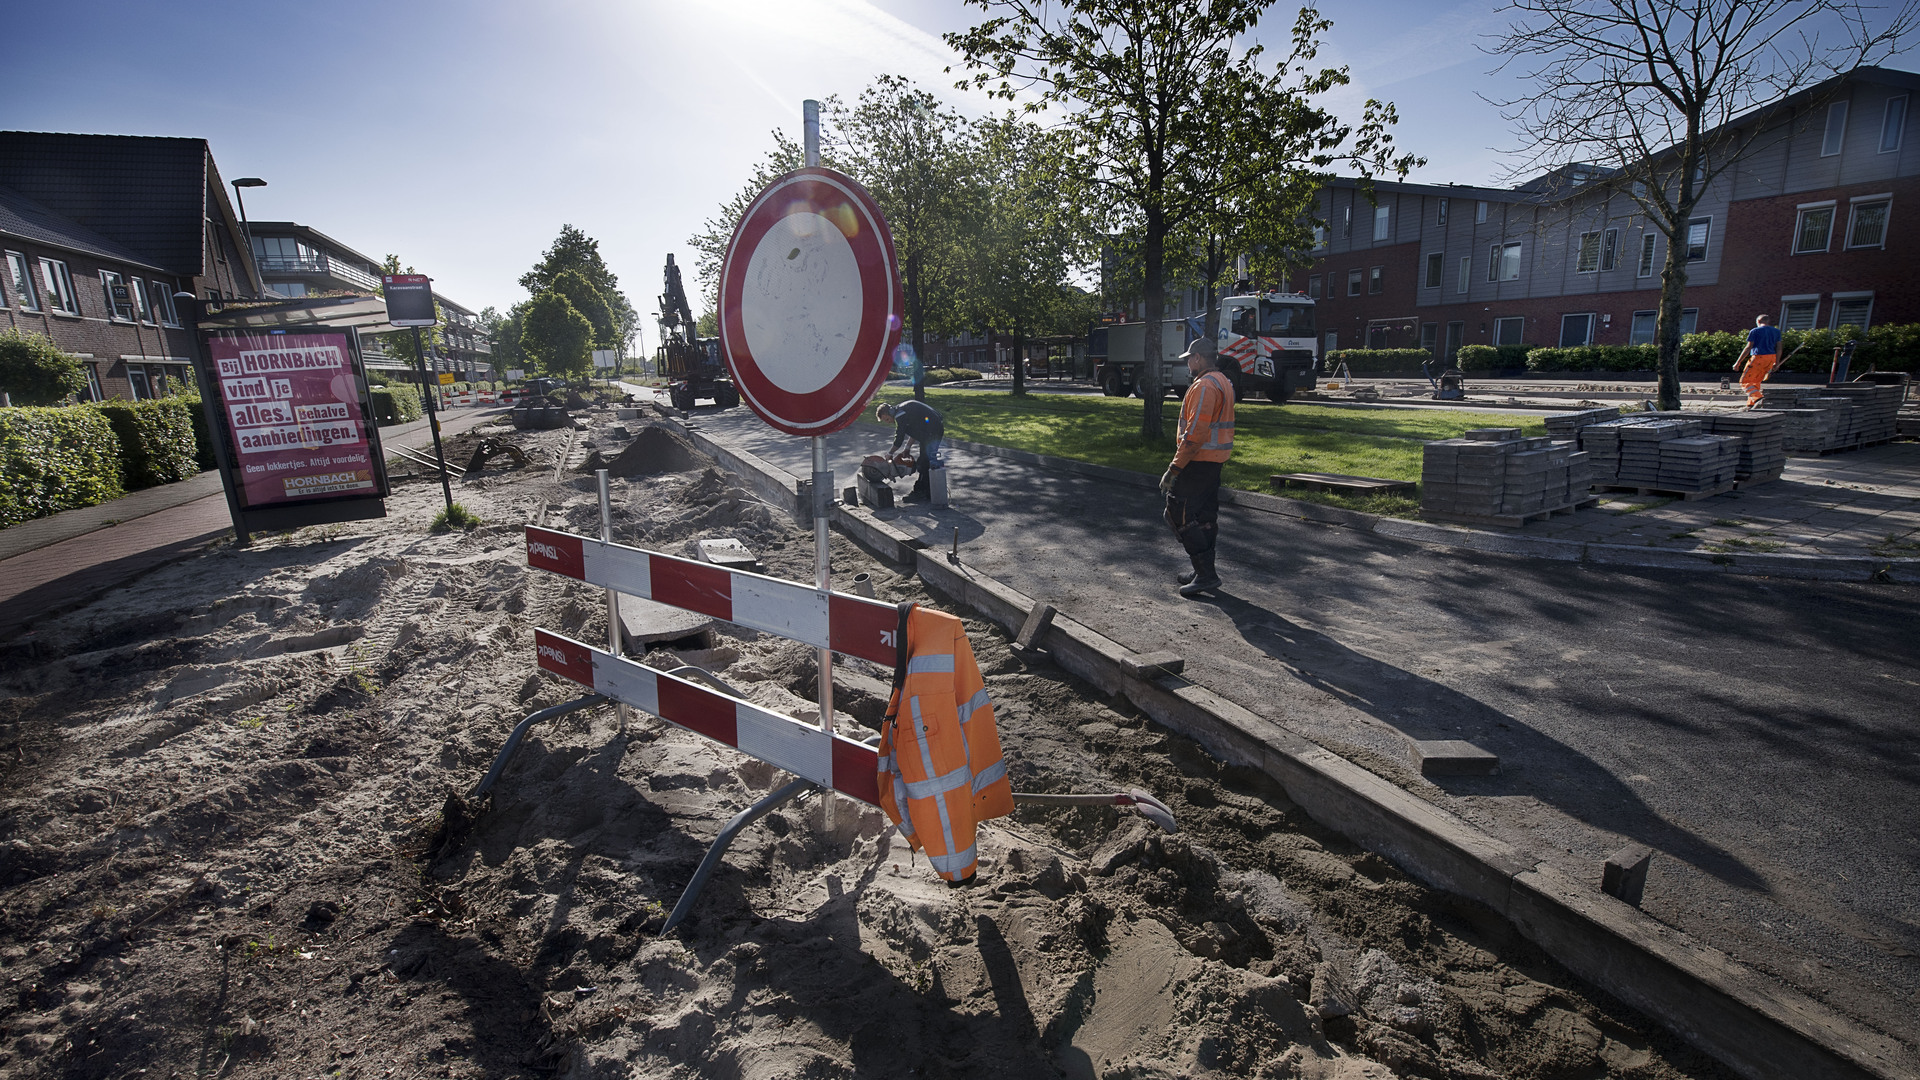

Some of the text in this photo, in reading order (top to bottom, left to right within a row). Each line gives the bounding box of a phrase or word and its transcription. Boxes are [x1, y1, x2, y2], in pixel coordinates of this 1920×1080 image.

[221, 350, 339, 375] Bij HORNBACH
[227, 379, 290, 398] vind je
[235, 405, 347, 426] alles. Behalve
[241, 426, 357, 448] aanbiedingen.
[246, 453, 368, 473] Geen lokkertjes. Altijd voordelig.
[284, 472, 356, 489] HORNBACH
